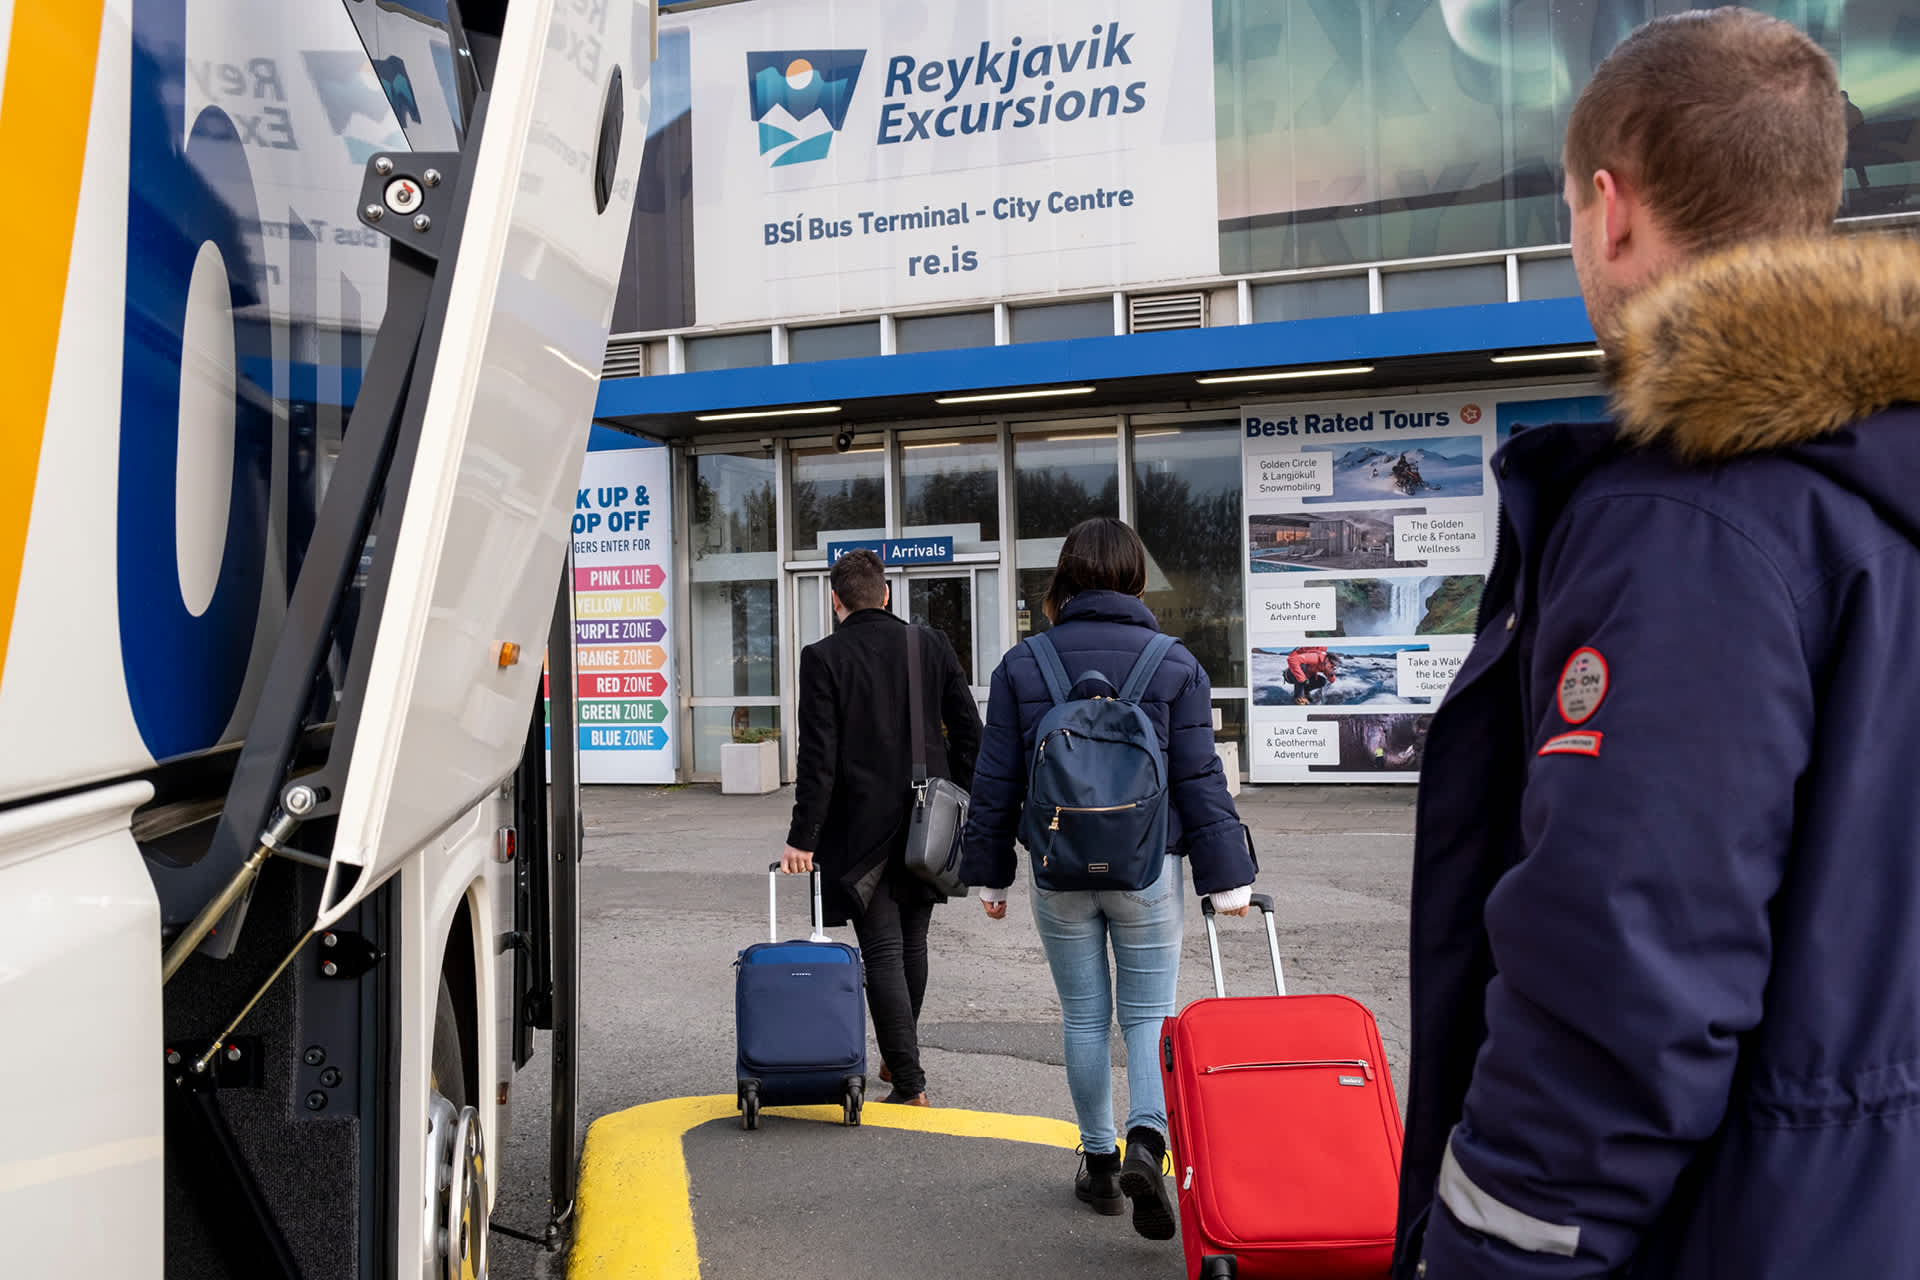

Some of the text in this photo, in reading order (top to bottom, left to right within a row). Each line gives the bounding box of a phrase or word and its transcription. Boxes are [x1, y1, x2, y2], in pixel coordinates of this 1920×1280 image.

[884, 21, 1136, 102] Reykjavik
[876, 81, 1147, 145] Excursions
[763, 213, 803, 245] BSÍ
[809, 217, 853, 239] Bus
[859, 202, 970, 235] Terminal
[993, 196, 1041, 223] City
[1047, 187, 1135, 214] Centre
[908, 245, 979, 277] re.is
[1246, 409, 1450, 438] Best Rated Tours
[1259, 458, 1317, 469] Golden Circle
[1259, 482, 1321, 493] Snowmobiling
[598, 486, 628, 508] UP
[635, 485, 650, 506] &
[608, 510, 650, 532] OFF
[1410, 519, 1464, 530] The Golden
[1401, 533, 1428, 542] Circle
[1438, 531, 1476, 541] Fontana
[600, 540, 630, 552] ENTER
[633, 539, 650, 551] FOR
[891, 543, 946, 559] Arrivals
[1417, 544, 1461, 553] Wellness
[590, 568, 651, 586] PINK LINE
[626, 595, 652, 612] LINE
[1265, 600, 1321, 610] South Shore
[1270, 612, 1317, 622] Adventure
[622, 622, 652, 638] ZONE
[578, 649, 652, 666] RANGE ZONE
[1407, 657, 1430, 667] Take
[1439, 657, 1462, 666] Walk
[1416, 670, 1431, 679] the
[1432, 669, 1446, 679] Ice
[596, 676, 653, 693] RED ZONE
[1420, 682, 1447, 690] Glacier
[581, 703, 653, 720] GREEN ZONE
[591, 729, 654, 746] BLUE ZONE
[1273, 726, 1318, 736] Lava Cave
[1274, 737, 1327, 748] Geothermal
[1273, 750, 1319, 760] Adventure
